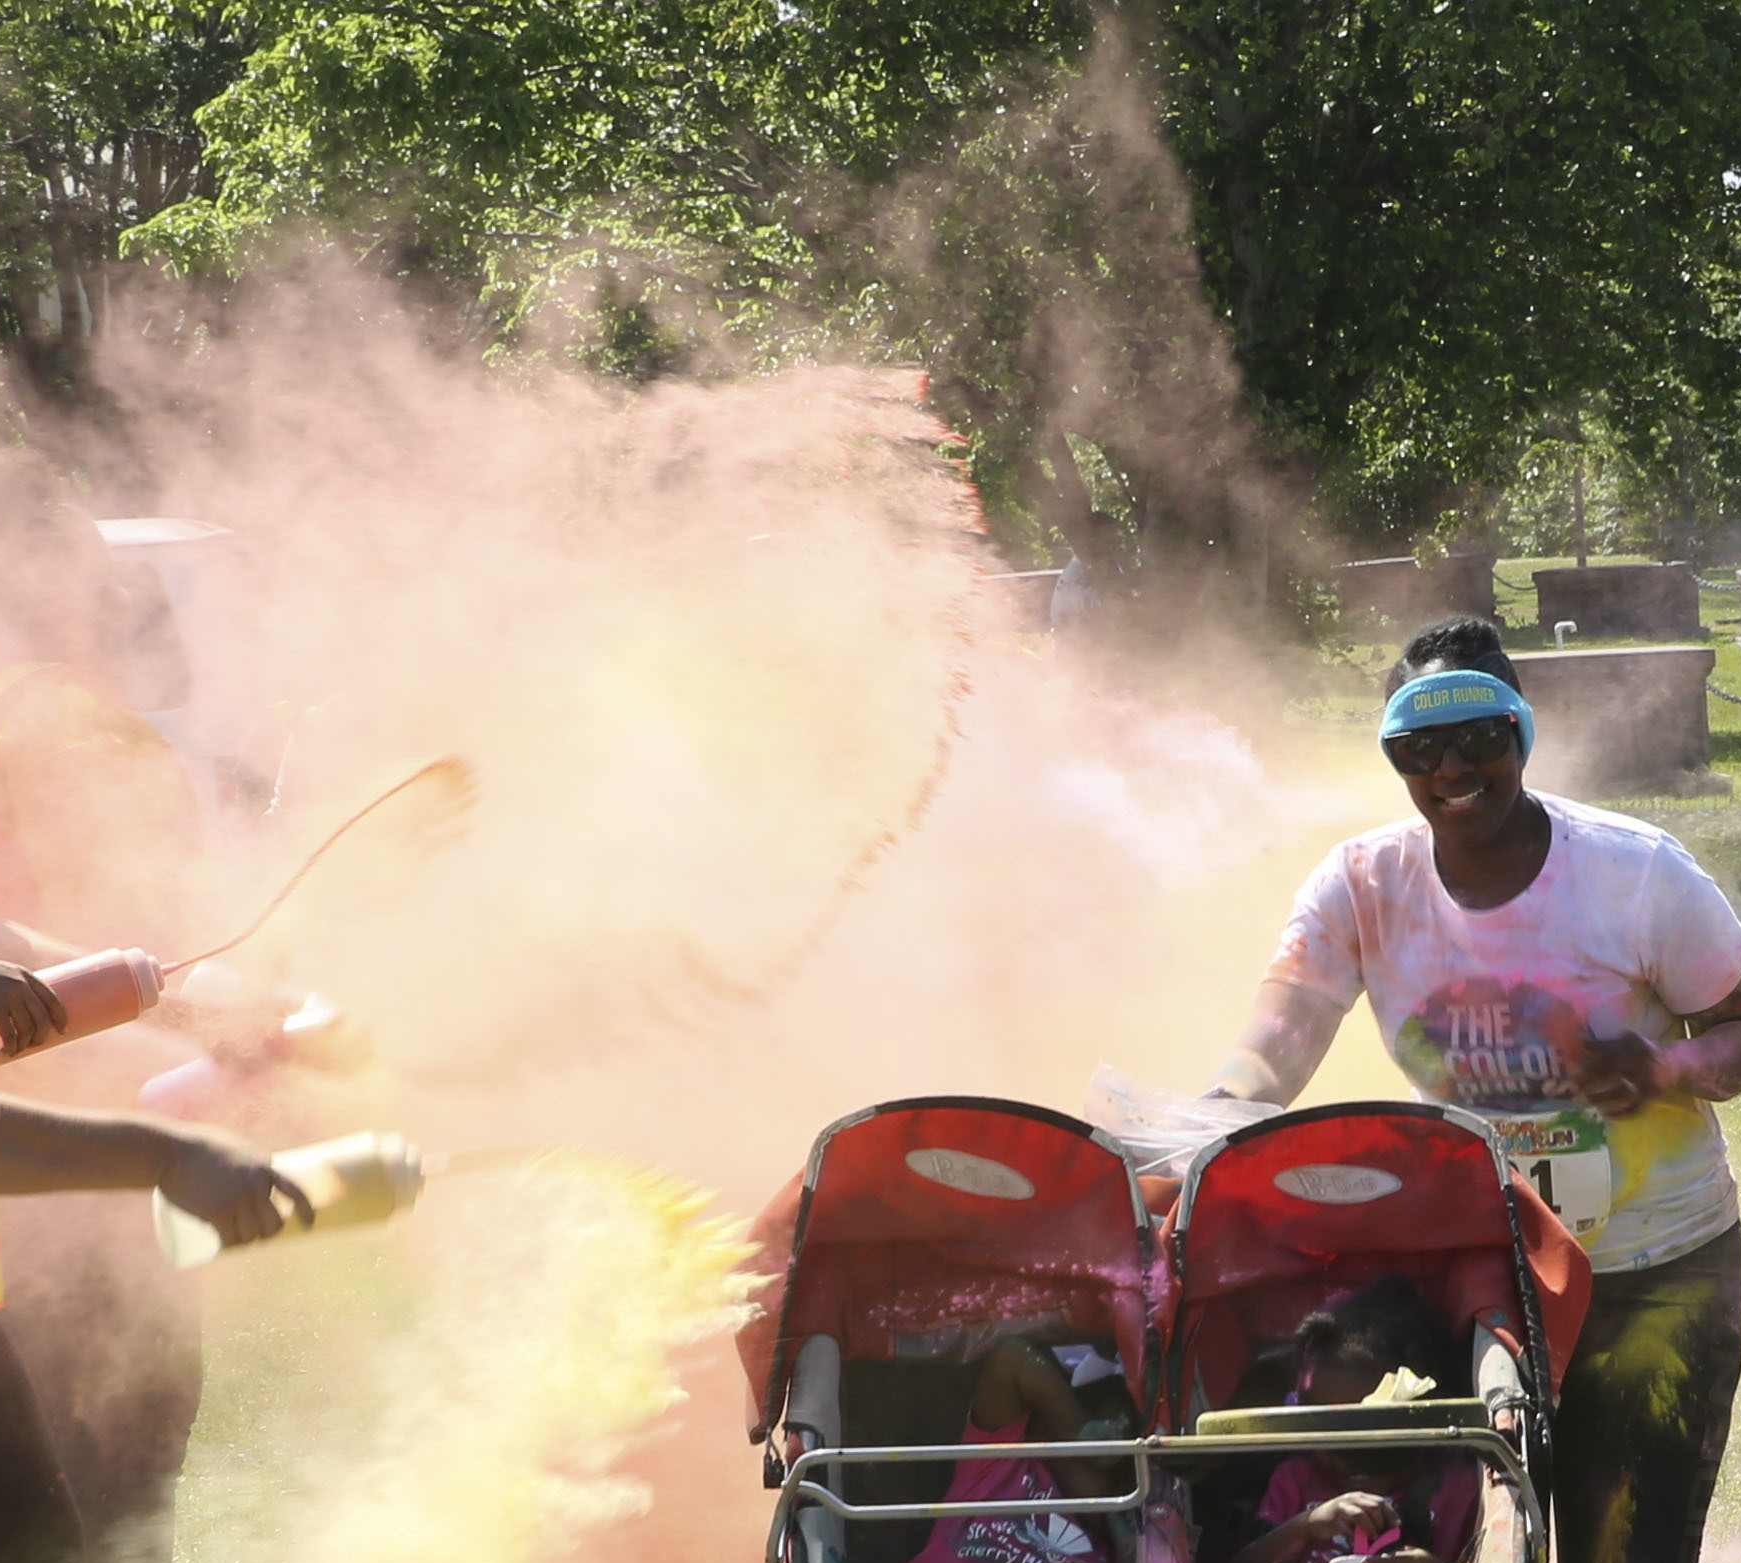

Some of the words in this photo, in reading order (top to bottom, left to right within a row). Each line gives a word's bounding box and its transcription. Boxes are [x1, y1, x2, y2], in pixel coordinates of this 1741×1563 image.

[1413, 689, 1450, 711] COLOR
[1452, 686, 1497, 704] RUNNER
[1445, 1002, 1514, 1049] THE
